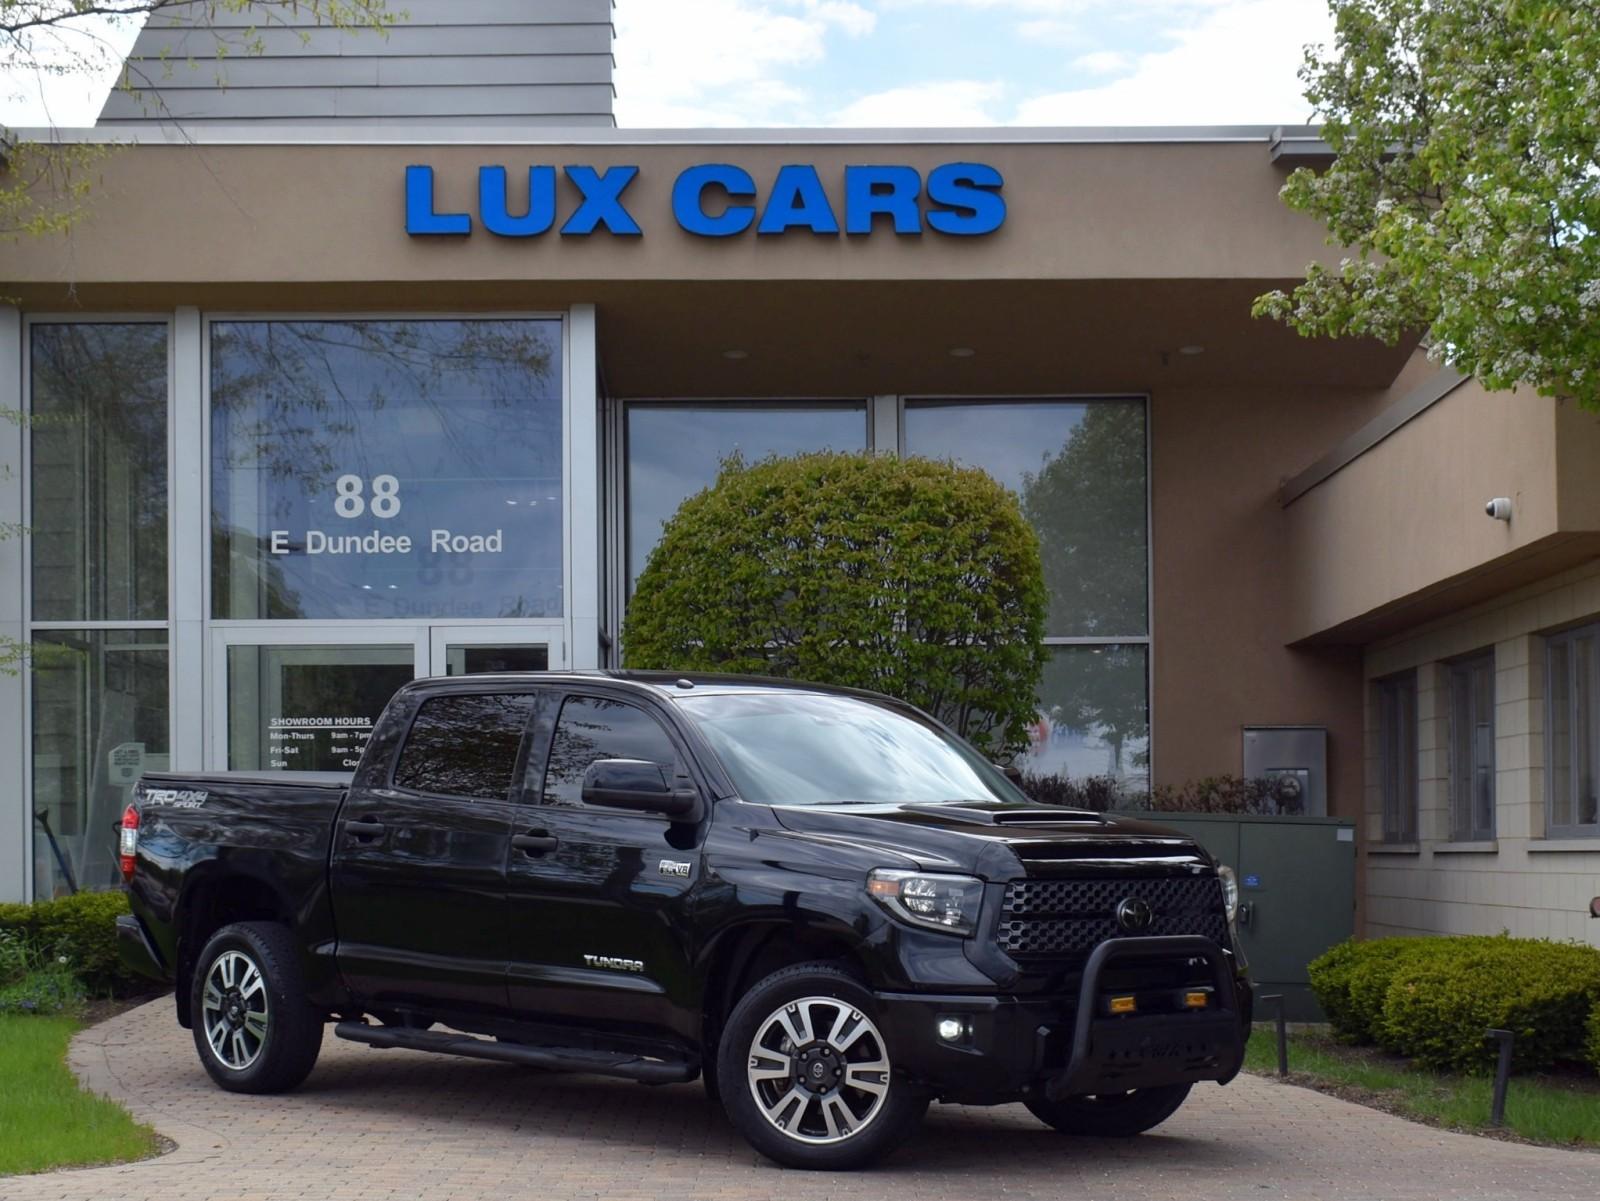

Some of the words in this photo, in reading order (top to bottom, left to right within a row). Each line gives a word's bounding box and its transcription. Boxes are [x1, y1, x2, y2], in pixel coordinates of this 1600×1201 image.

[405, 164, 643, 237] LUX
[671, 161, 1007, 237] CARS
[334, 474, 401, 518] 88
[271, 530, 290, 554] E
[306, 530, 412, 554] Dundee
[431, 529, 502, 553] Road
[271, 717, 333, 726] SHOWROOM
[335, 717, 371, 725] HOURS
[270, 732, 315, 740] Mon-Thurs
[270, 746, 299, 754] Fri-Sat
[331, 746, 348, 754] 9am
[354, 746, 365, 754] 5p
[583, 954, 645, 972] TUNDRA
